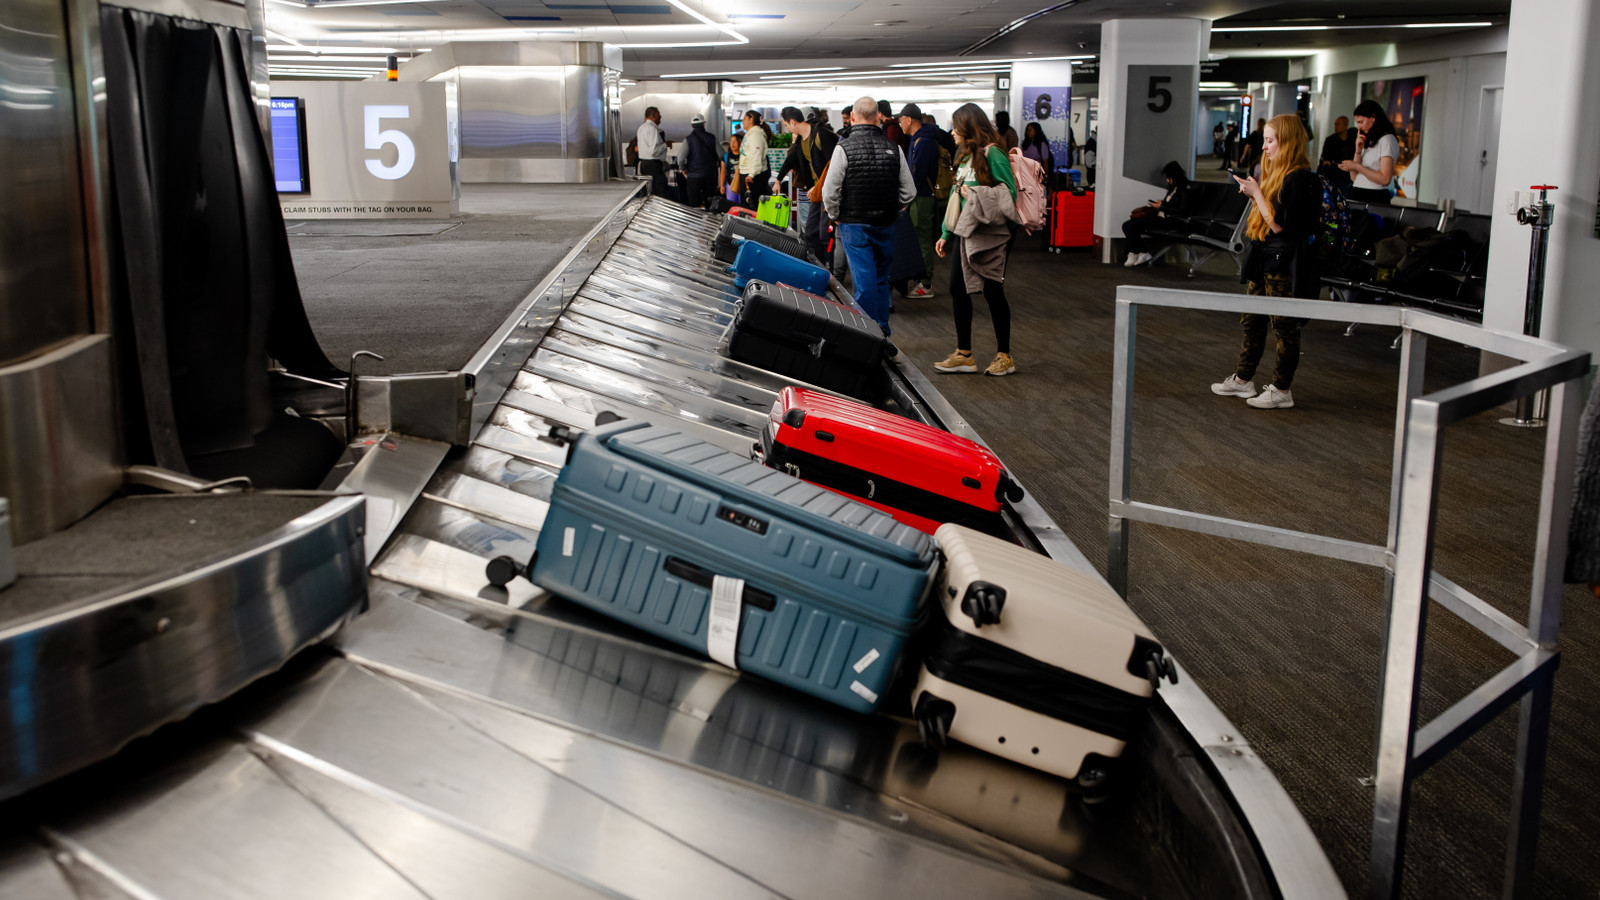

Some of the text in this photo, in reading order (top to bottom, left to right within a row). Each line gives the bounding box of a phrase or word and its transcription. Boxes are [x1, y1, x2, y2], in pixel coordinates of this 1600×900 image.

[1035, 93, 1052, 120] 6
[1147, 76, 1172, 113] 5
[737, 109, 743, 120] 7
[1073, 112, 1081, 123] 7
[364, 105, 416, 180] 5
